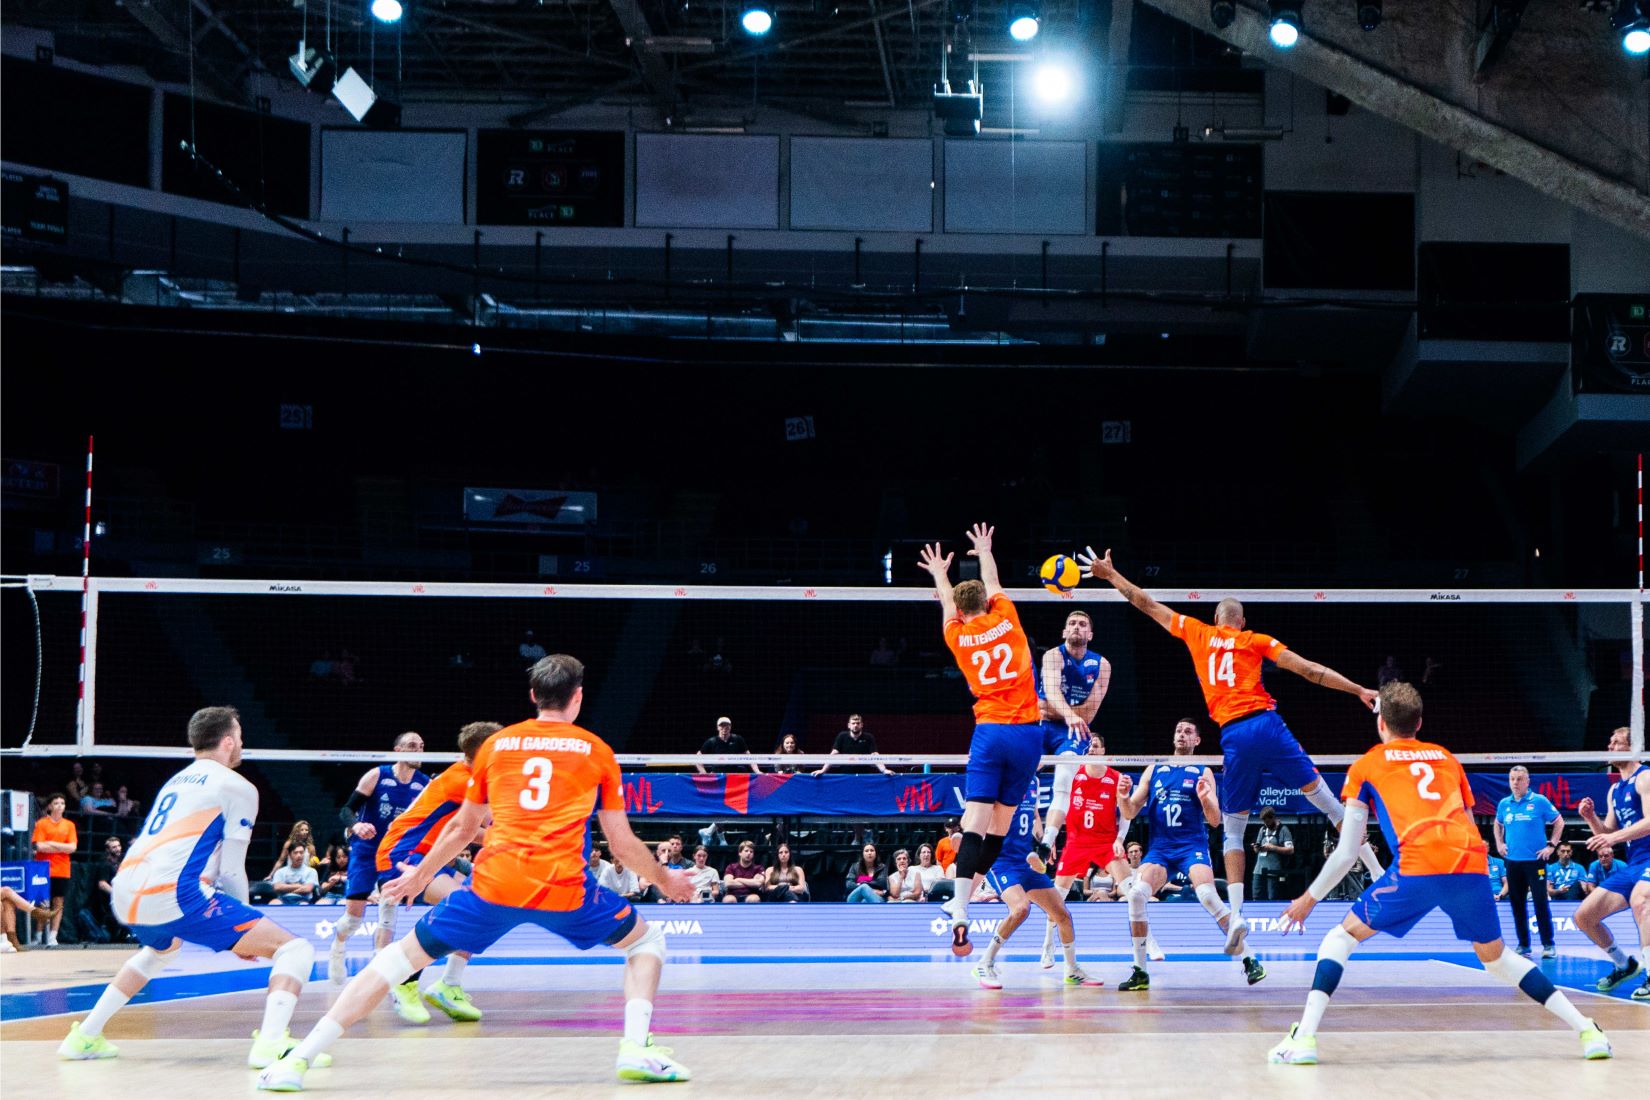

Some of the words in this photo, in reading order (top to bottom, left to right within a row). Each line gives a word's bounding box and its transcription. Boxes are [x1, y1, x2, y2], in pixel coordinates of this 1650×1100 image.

[787, 420, 805, 437] 26
[1104, 425, 1121, 439] 27
[213, 547, 231, 559] 25
[574, 560, 591, 572] 25
[700, 562, 717, 574] 26
[1145, 566, 1160, 577] 27
[971, 643, 1018, 686] 22
[1208, 651, 1237, 687] 14
[494, 736, 521, 752] VAN
[521, 736, 592, 756] GARDEREN
[1384, 749, 1448, 762] KEEMINK
[518, 756, 554, 811] 3
[1408, 761, 1442, 800] 2
[896, 780, 942, 812] VNL
[1260, 787, 1306, 798] olleybal
[147, 792, 178, 836] 8
[1083, 810, 1095, 829] 6
[1163, 803, 1182, 827] 12
[1018, 813, 1030, 836] 9
[1001, 875, 1008, 885] 9
[1247, 917, 1307, 932] TTAA
